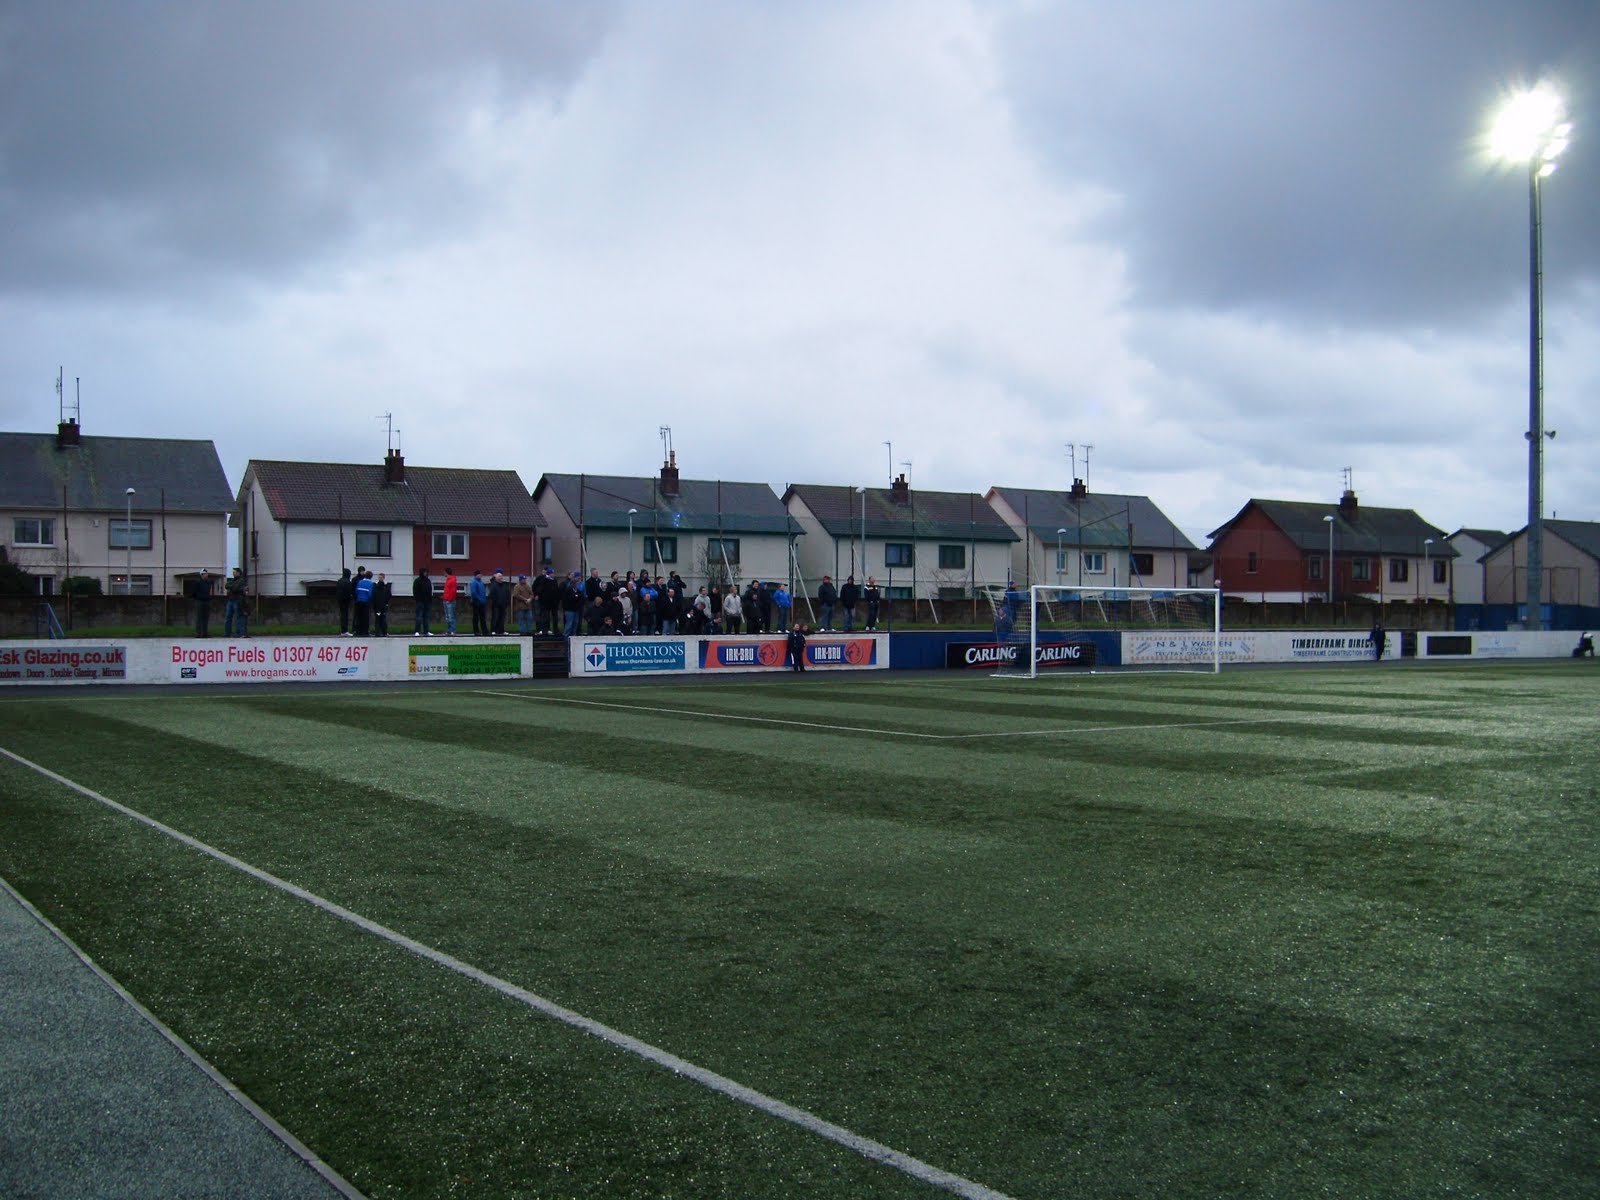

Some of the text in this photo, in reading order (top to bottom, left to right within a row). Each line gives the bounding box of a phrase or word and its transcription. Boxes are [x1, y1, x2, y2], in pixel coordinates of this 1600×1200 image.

[1191, 640, 1232, 648] WAREN
[1291, 639, 1345, 649] TIMBERFRAME
[172, 646, 369, 667] Brogan Fuels 01307 467 467
[607, 645, 684, 657] THORNTONS
[965, 646, 1017, 663] CARLING
[1327, 649, 1363, 657] CONSTRUCTION
[24, 648, 124, 668] Glazing.co.uk
[225, 667, 317, 679] www.brogans.co.uk
[409, 665, 449, 673] HUNTER
